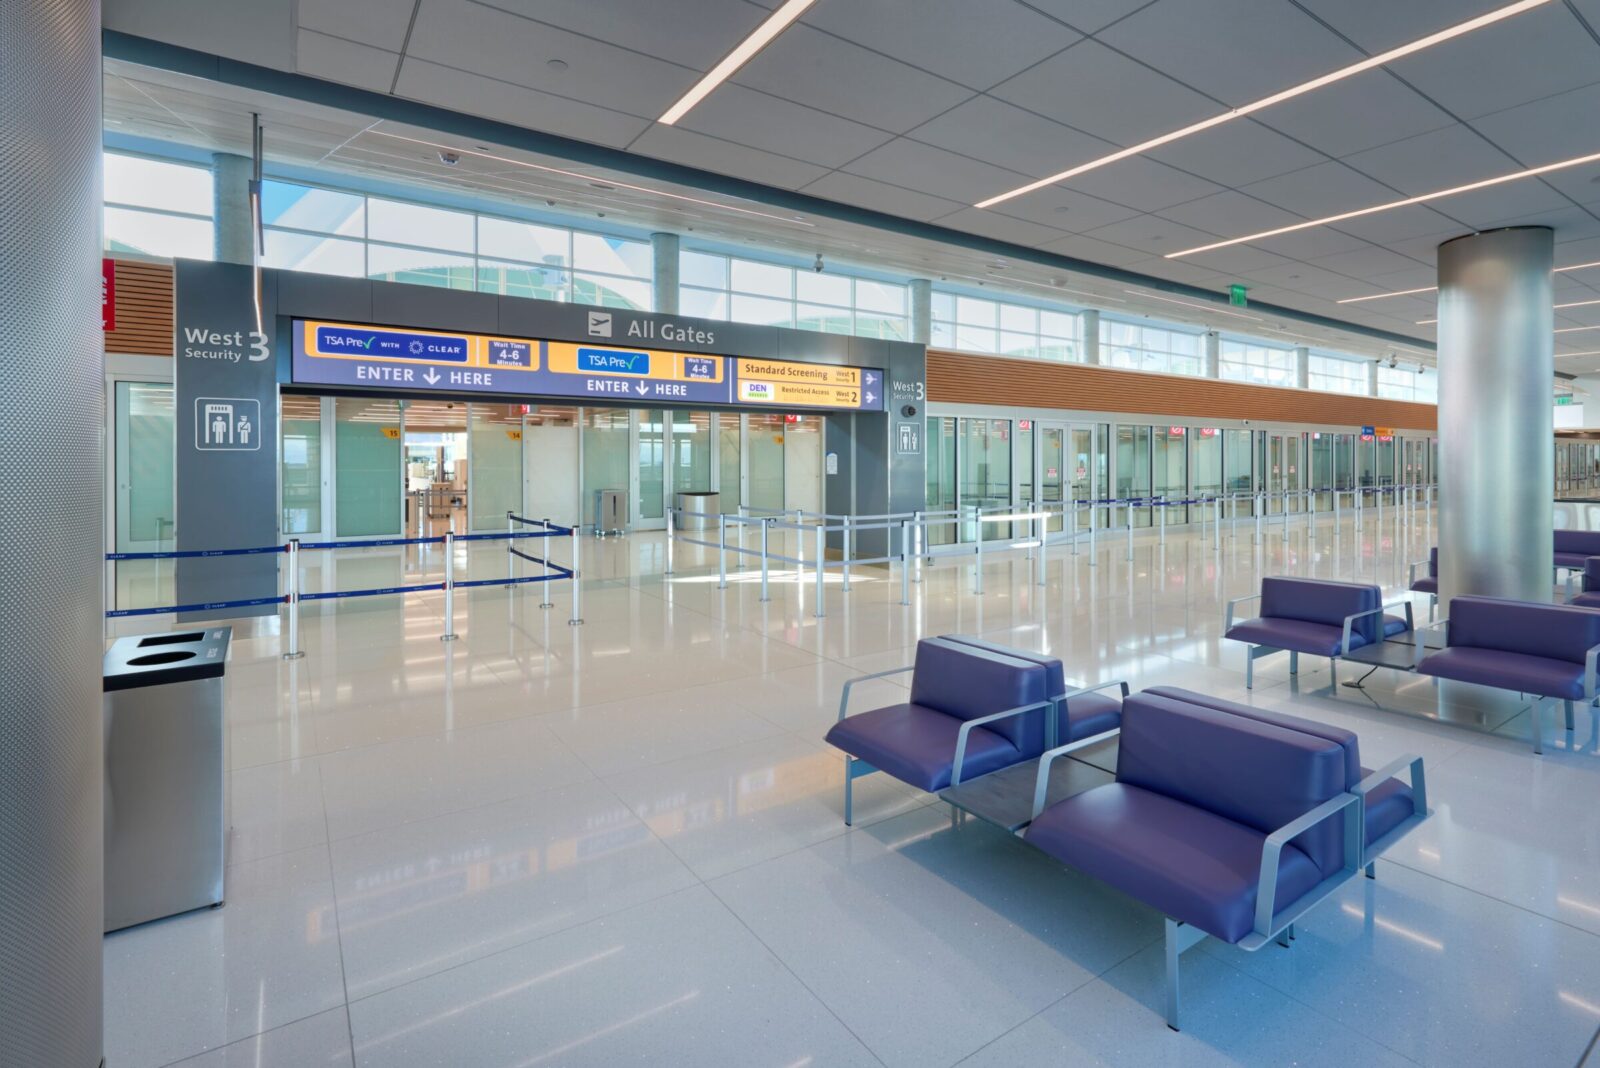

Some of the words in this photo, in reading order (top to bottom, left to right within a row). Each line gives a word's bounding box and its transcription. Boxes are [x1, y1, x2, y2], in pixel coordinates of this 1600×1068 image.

[184, 327, 243, 347] West
[627, 320, 654, 338] All
[660, 324, 715, 345] Gates
[248, 331, 270, 362] 3
[324, 335, 344, 346] TSA
[346, 337, 363, 348] Pre
[380, 341, 400, 349] WITH
[428, 345, 460, 354] CLEAR
[493, 341, 509, 349] Wait
[510, 342, 526, 350] Time
[184, 347, 242, 363] Security
[499, 349, 520, 360] 4-6
[496, 359, 523, 367] Minutes
[588, 355, 608, 367] TSA
[609, 357, 626, 368] Pre
[356, 365, 415, 382] ENTER
[450, 371, 493, 386] HERE
[692, 365, 708, 374] 4-6
[745, 364, 786, 376] Standard
[787, 367, 829, 381] Screening
[851, 372, 856, 383] 1
[587, 380, 630, 393] ENTER
[655, 384, 688, 396] HERE
[749, 384, 767, 392] DEN
[781, 386, 811, 395] Restricted
[811, 388, 830, 396] Access
[892, 380, 915, 391] West
[916, 381, 924, 401] 3
[851, 391, 858, 403] 2
[892, 392, 915, 401] Security
